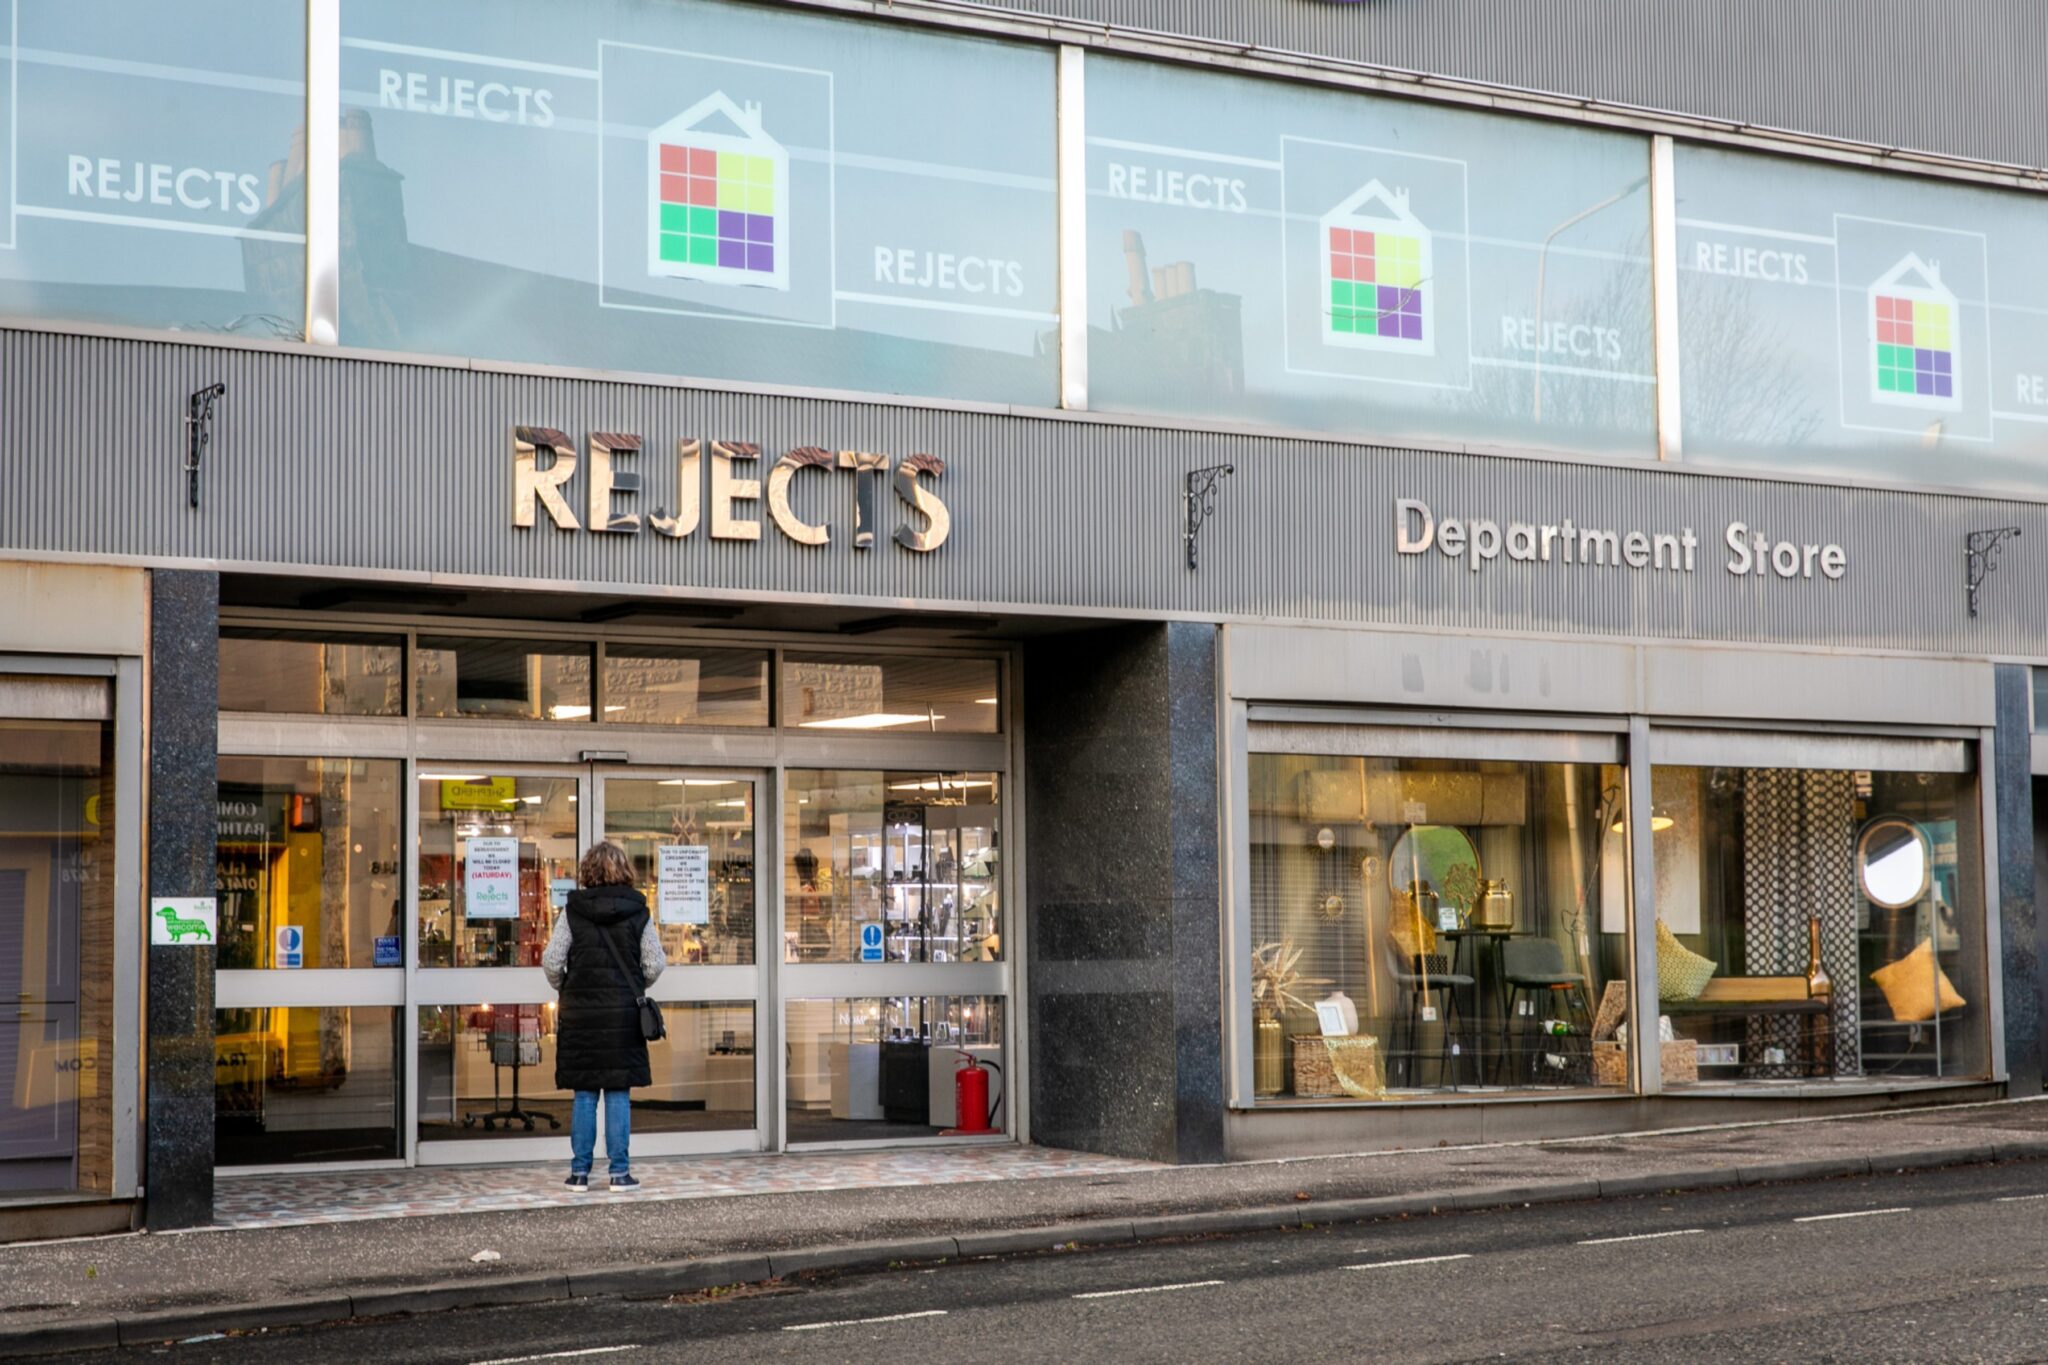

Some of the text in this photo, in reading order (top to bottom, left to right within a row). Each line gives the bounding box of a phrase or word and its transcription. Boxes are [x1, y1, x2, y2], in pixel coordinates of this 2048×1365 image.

[379, 68, 555, 128] REJECTS
[68, 154, 261, 215] REJECTS
[1109, 163, 1247, 213] REJECTS
[875, 246, 1024, 298] REJECTS
[1696, 242, 1808, 285] REJECTS
[1502, 315, 1622, 361] REJECTS
[2016, 373, 2048, 404] RE
[511, 425, 951, 553] REJECTS
[1395, 497, 1847, 580] Department Store
[471, 872, 512, 880] (SATURDAY)
[476, 891, 508, 902] Rejects
